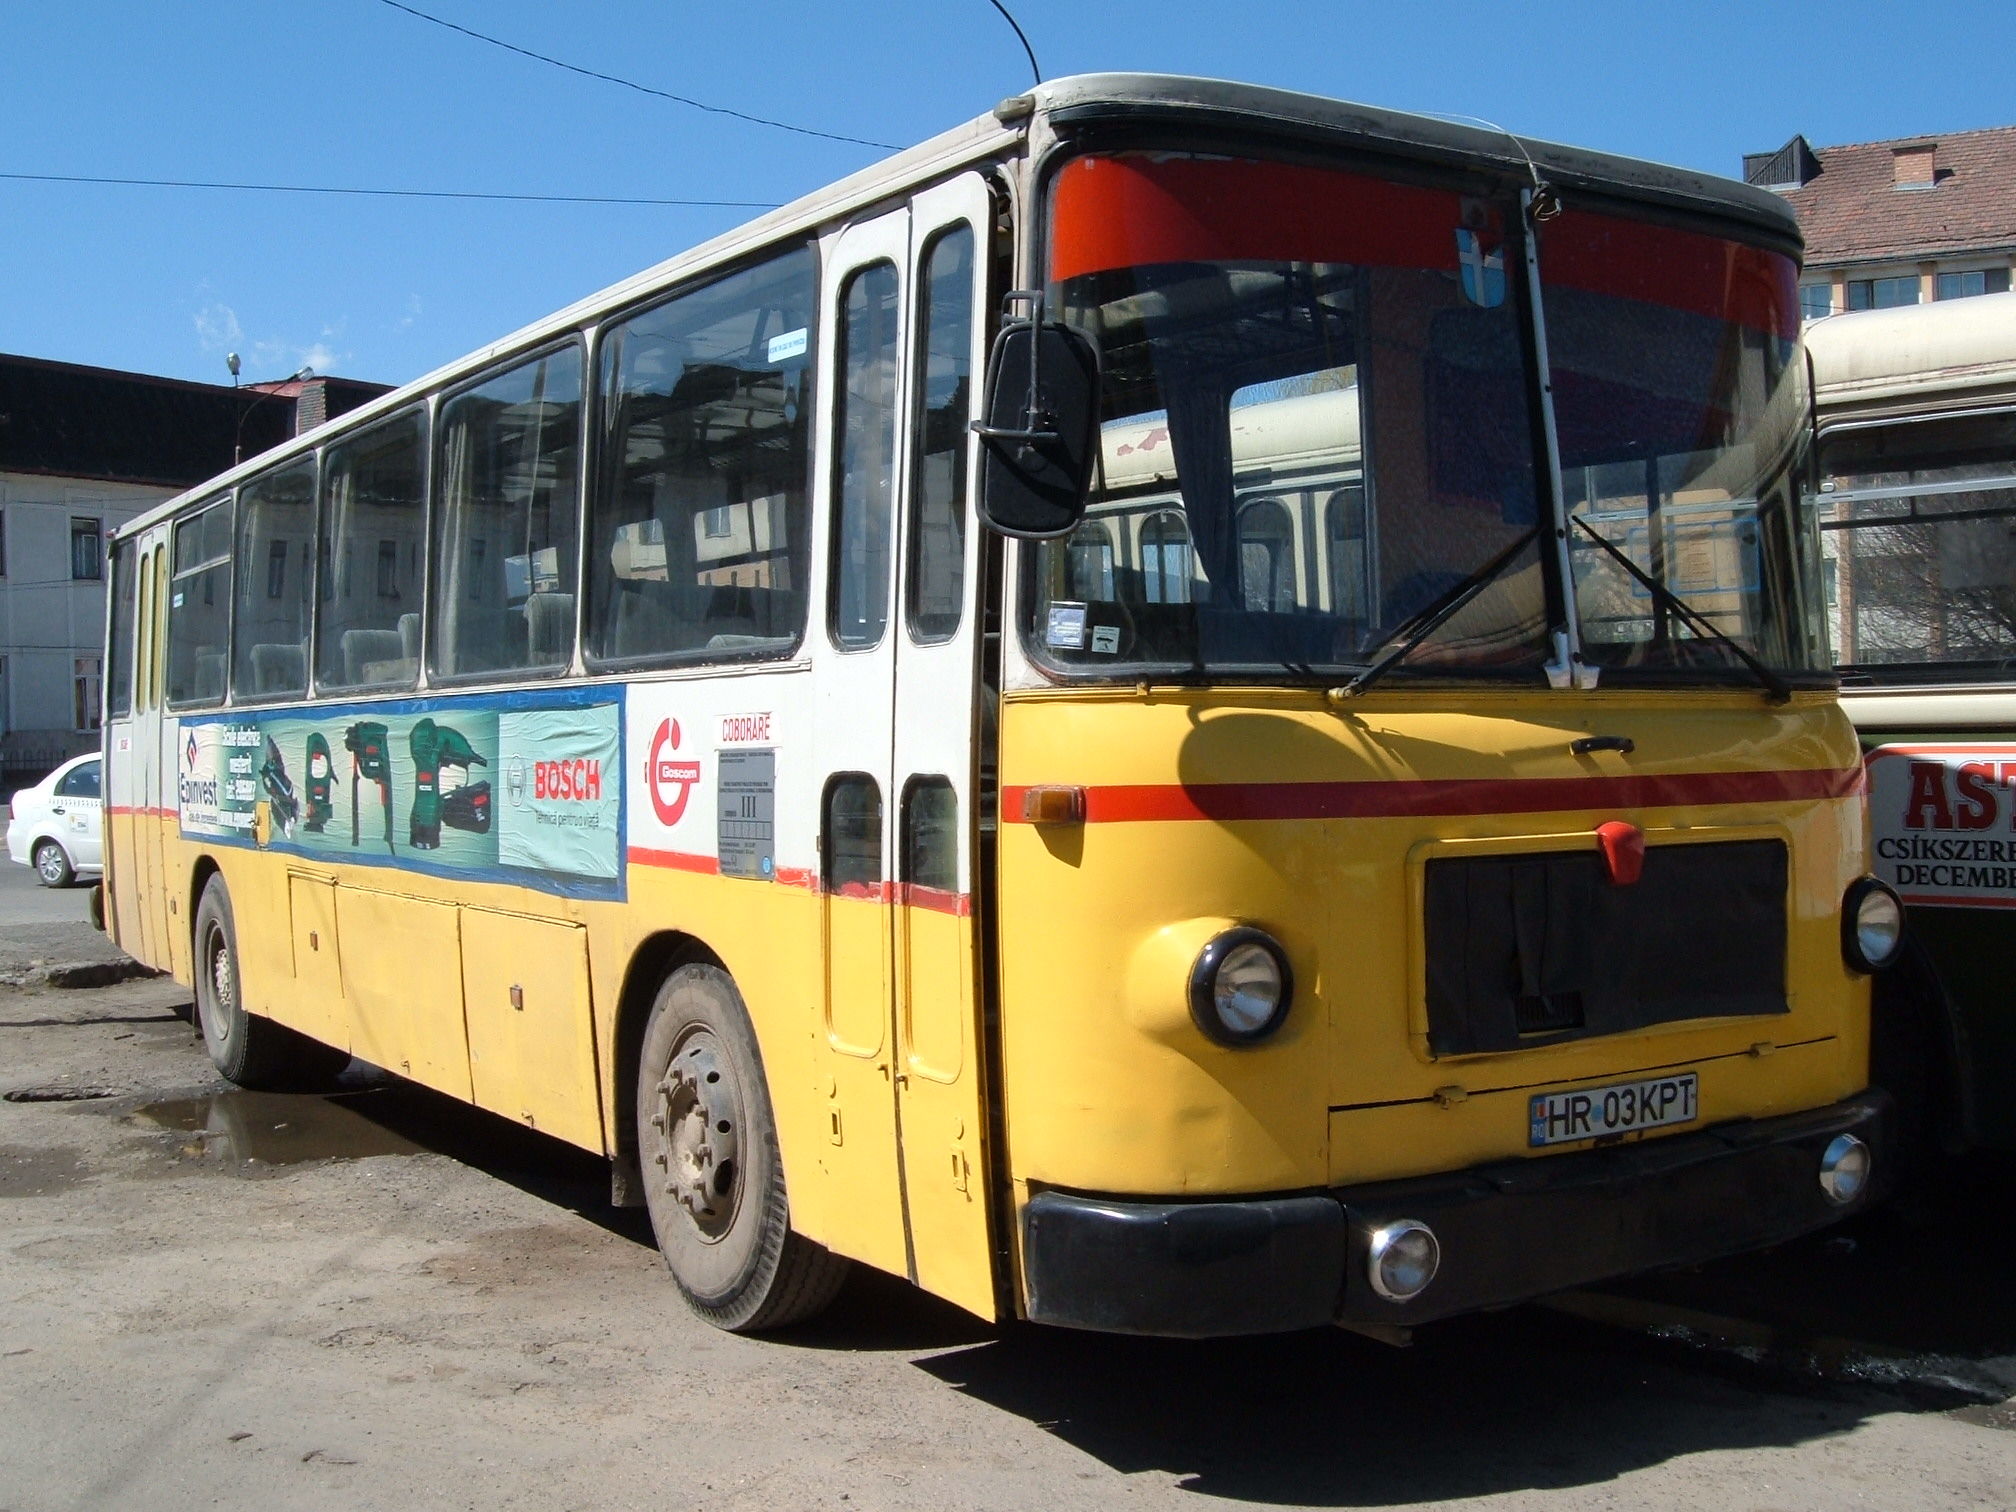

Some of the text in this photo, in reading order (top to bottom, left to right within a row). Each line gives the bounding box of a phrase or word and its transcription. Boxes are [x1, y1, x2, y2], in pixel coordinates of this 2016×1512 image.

[534, 759, 600, 800] BOSCH
[662, 765, 697, 779] Goscom
[1548, 1095, 1592, 1138] HR
